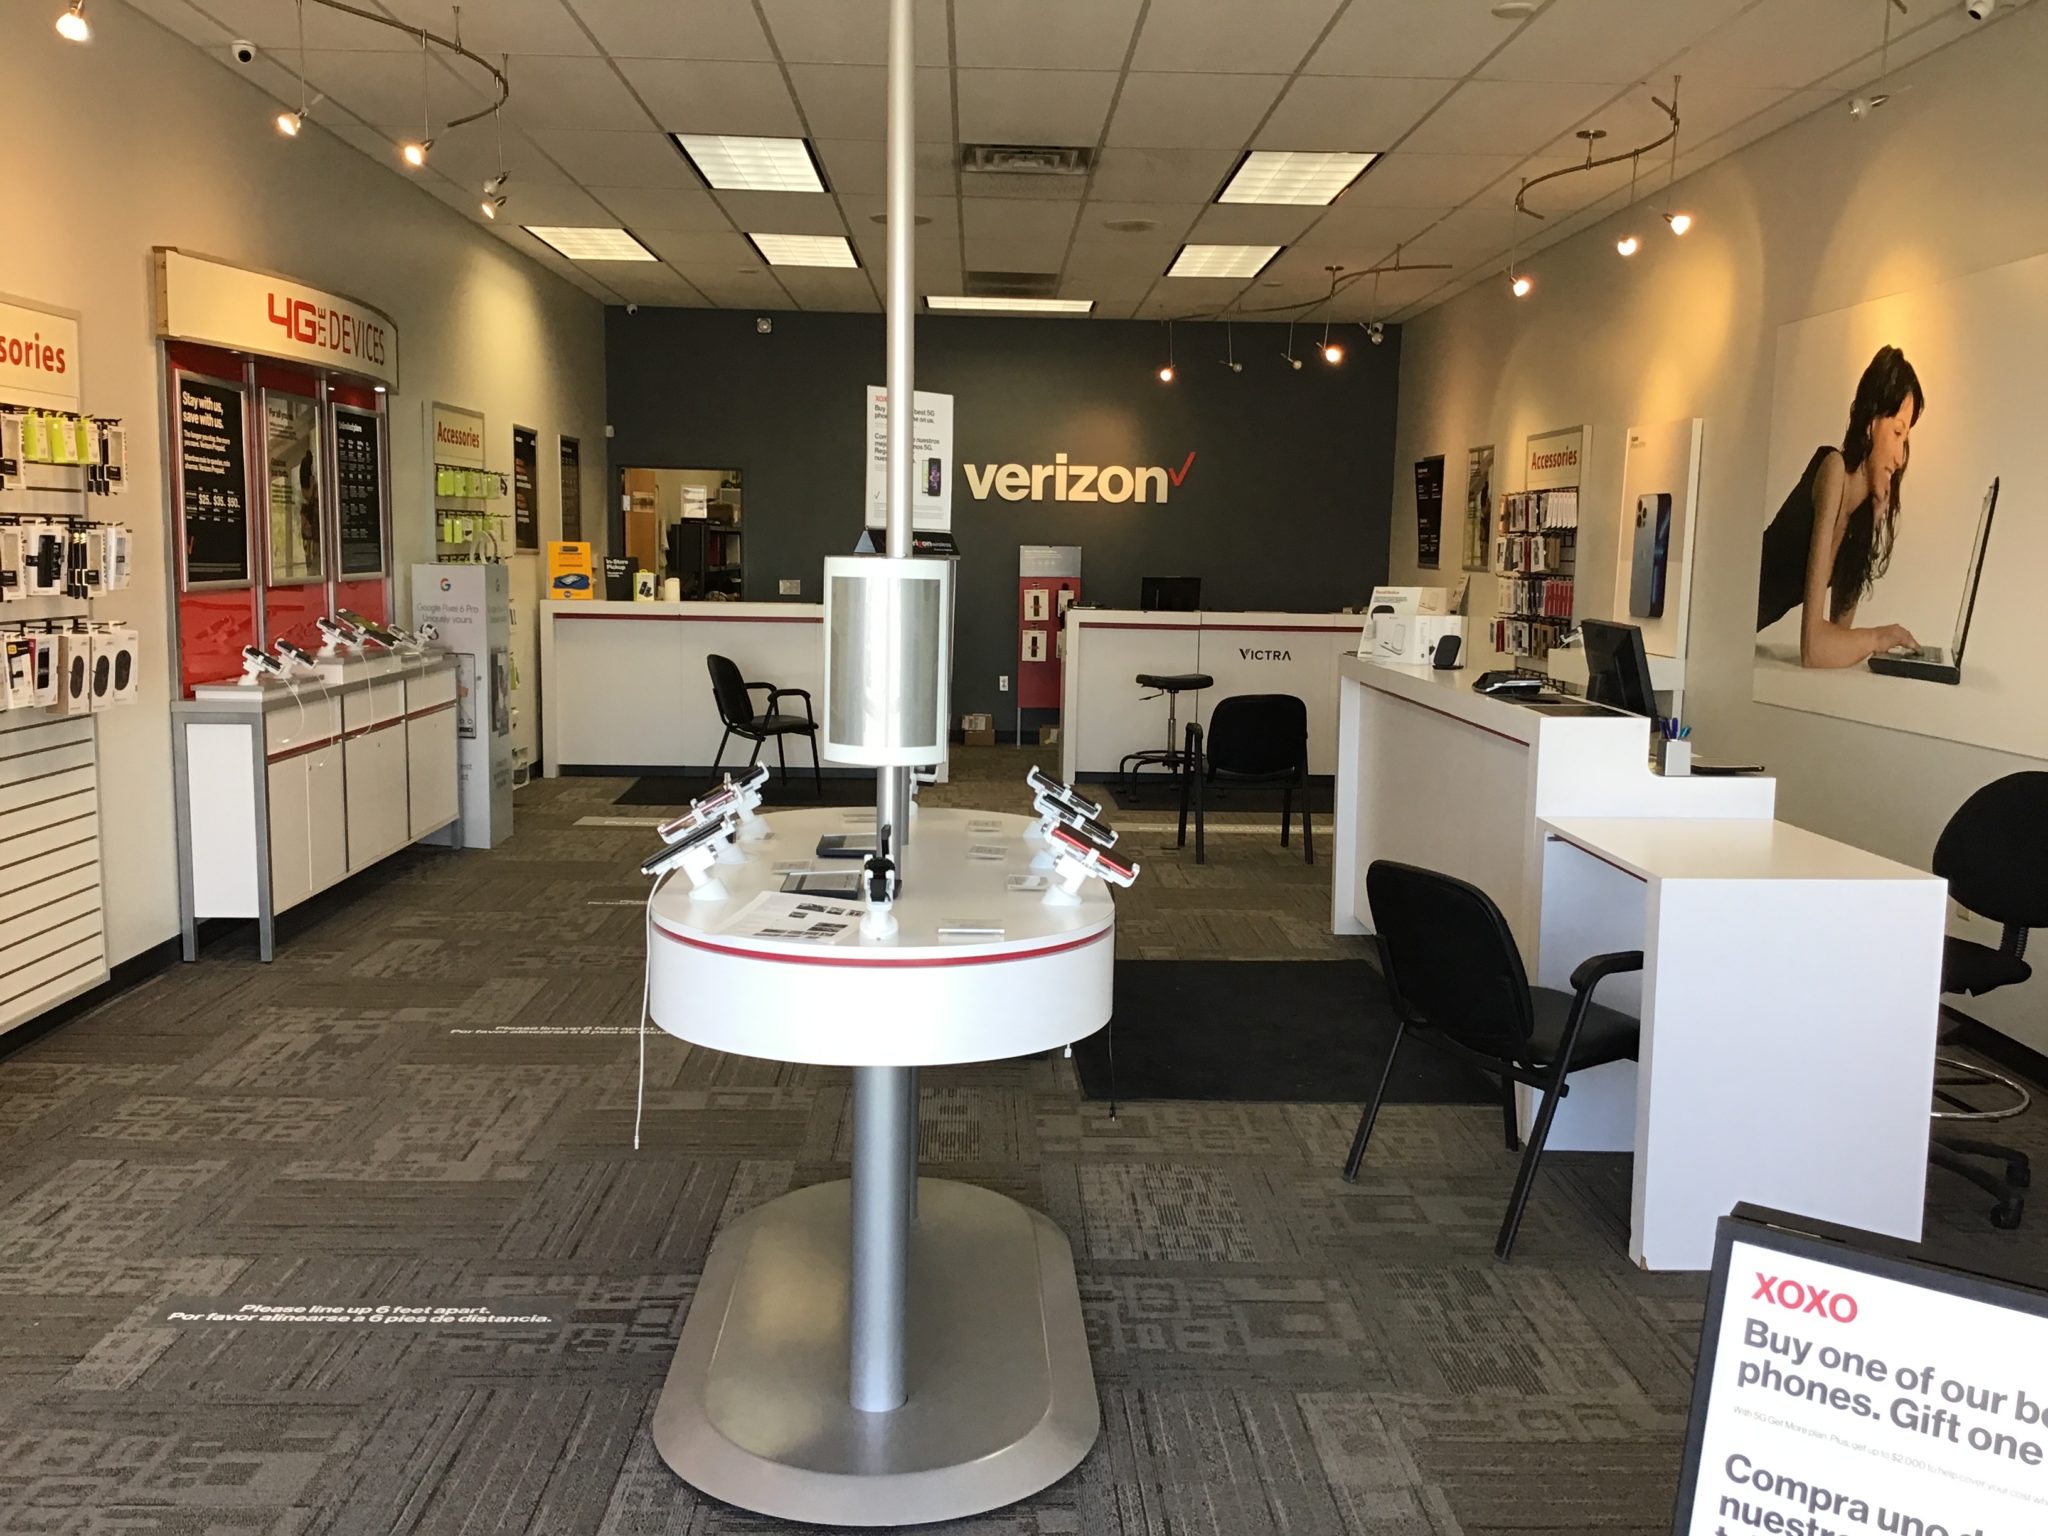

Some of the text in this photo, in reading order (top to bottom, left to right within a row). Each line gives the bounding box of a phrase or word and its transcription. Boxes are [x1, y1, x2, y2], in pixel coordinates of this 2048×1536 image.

[268, 293, 317, 344] 4G
[329, 310, 385, 366] DEVICES
[437, 421, 479, 448] Accessories
[1531, 445, 1578, 470] Accessories
[963, 453, 1168, 503] verizon
[1239, 648, 1291, 661] VICTRA
[239, 1304, 491, 1316] Please line up 6 feet apart.
[1752, 1272, 1858, 1323] XOXO
[167, 1312, 205, 1321] Por
[206, 1312, 259, 1321] favor
[258, 1313, 351, 1322] alinearse
[368, 1314, 384, 1323] 6
[384, 1314, 427, 1324] pies
[429, 1315, 455, 1323] de
[457, 1314, 552, 1323] distancia.
[1744, 1317, 1813, 1366] Buy
[1818, 1346, 1888, 1382] one
[1895, 1366, 1935, 1395] of
[1940, 1379, 2008, 1414] our
[1737, 1359, 2043, 1466] phones. Gift one
[1753, 1411, 1767, 1423] 5G
[1768, 1415, 1784, 1427] Get
[1725, 1453, 1869, 1525] Compra
